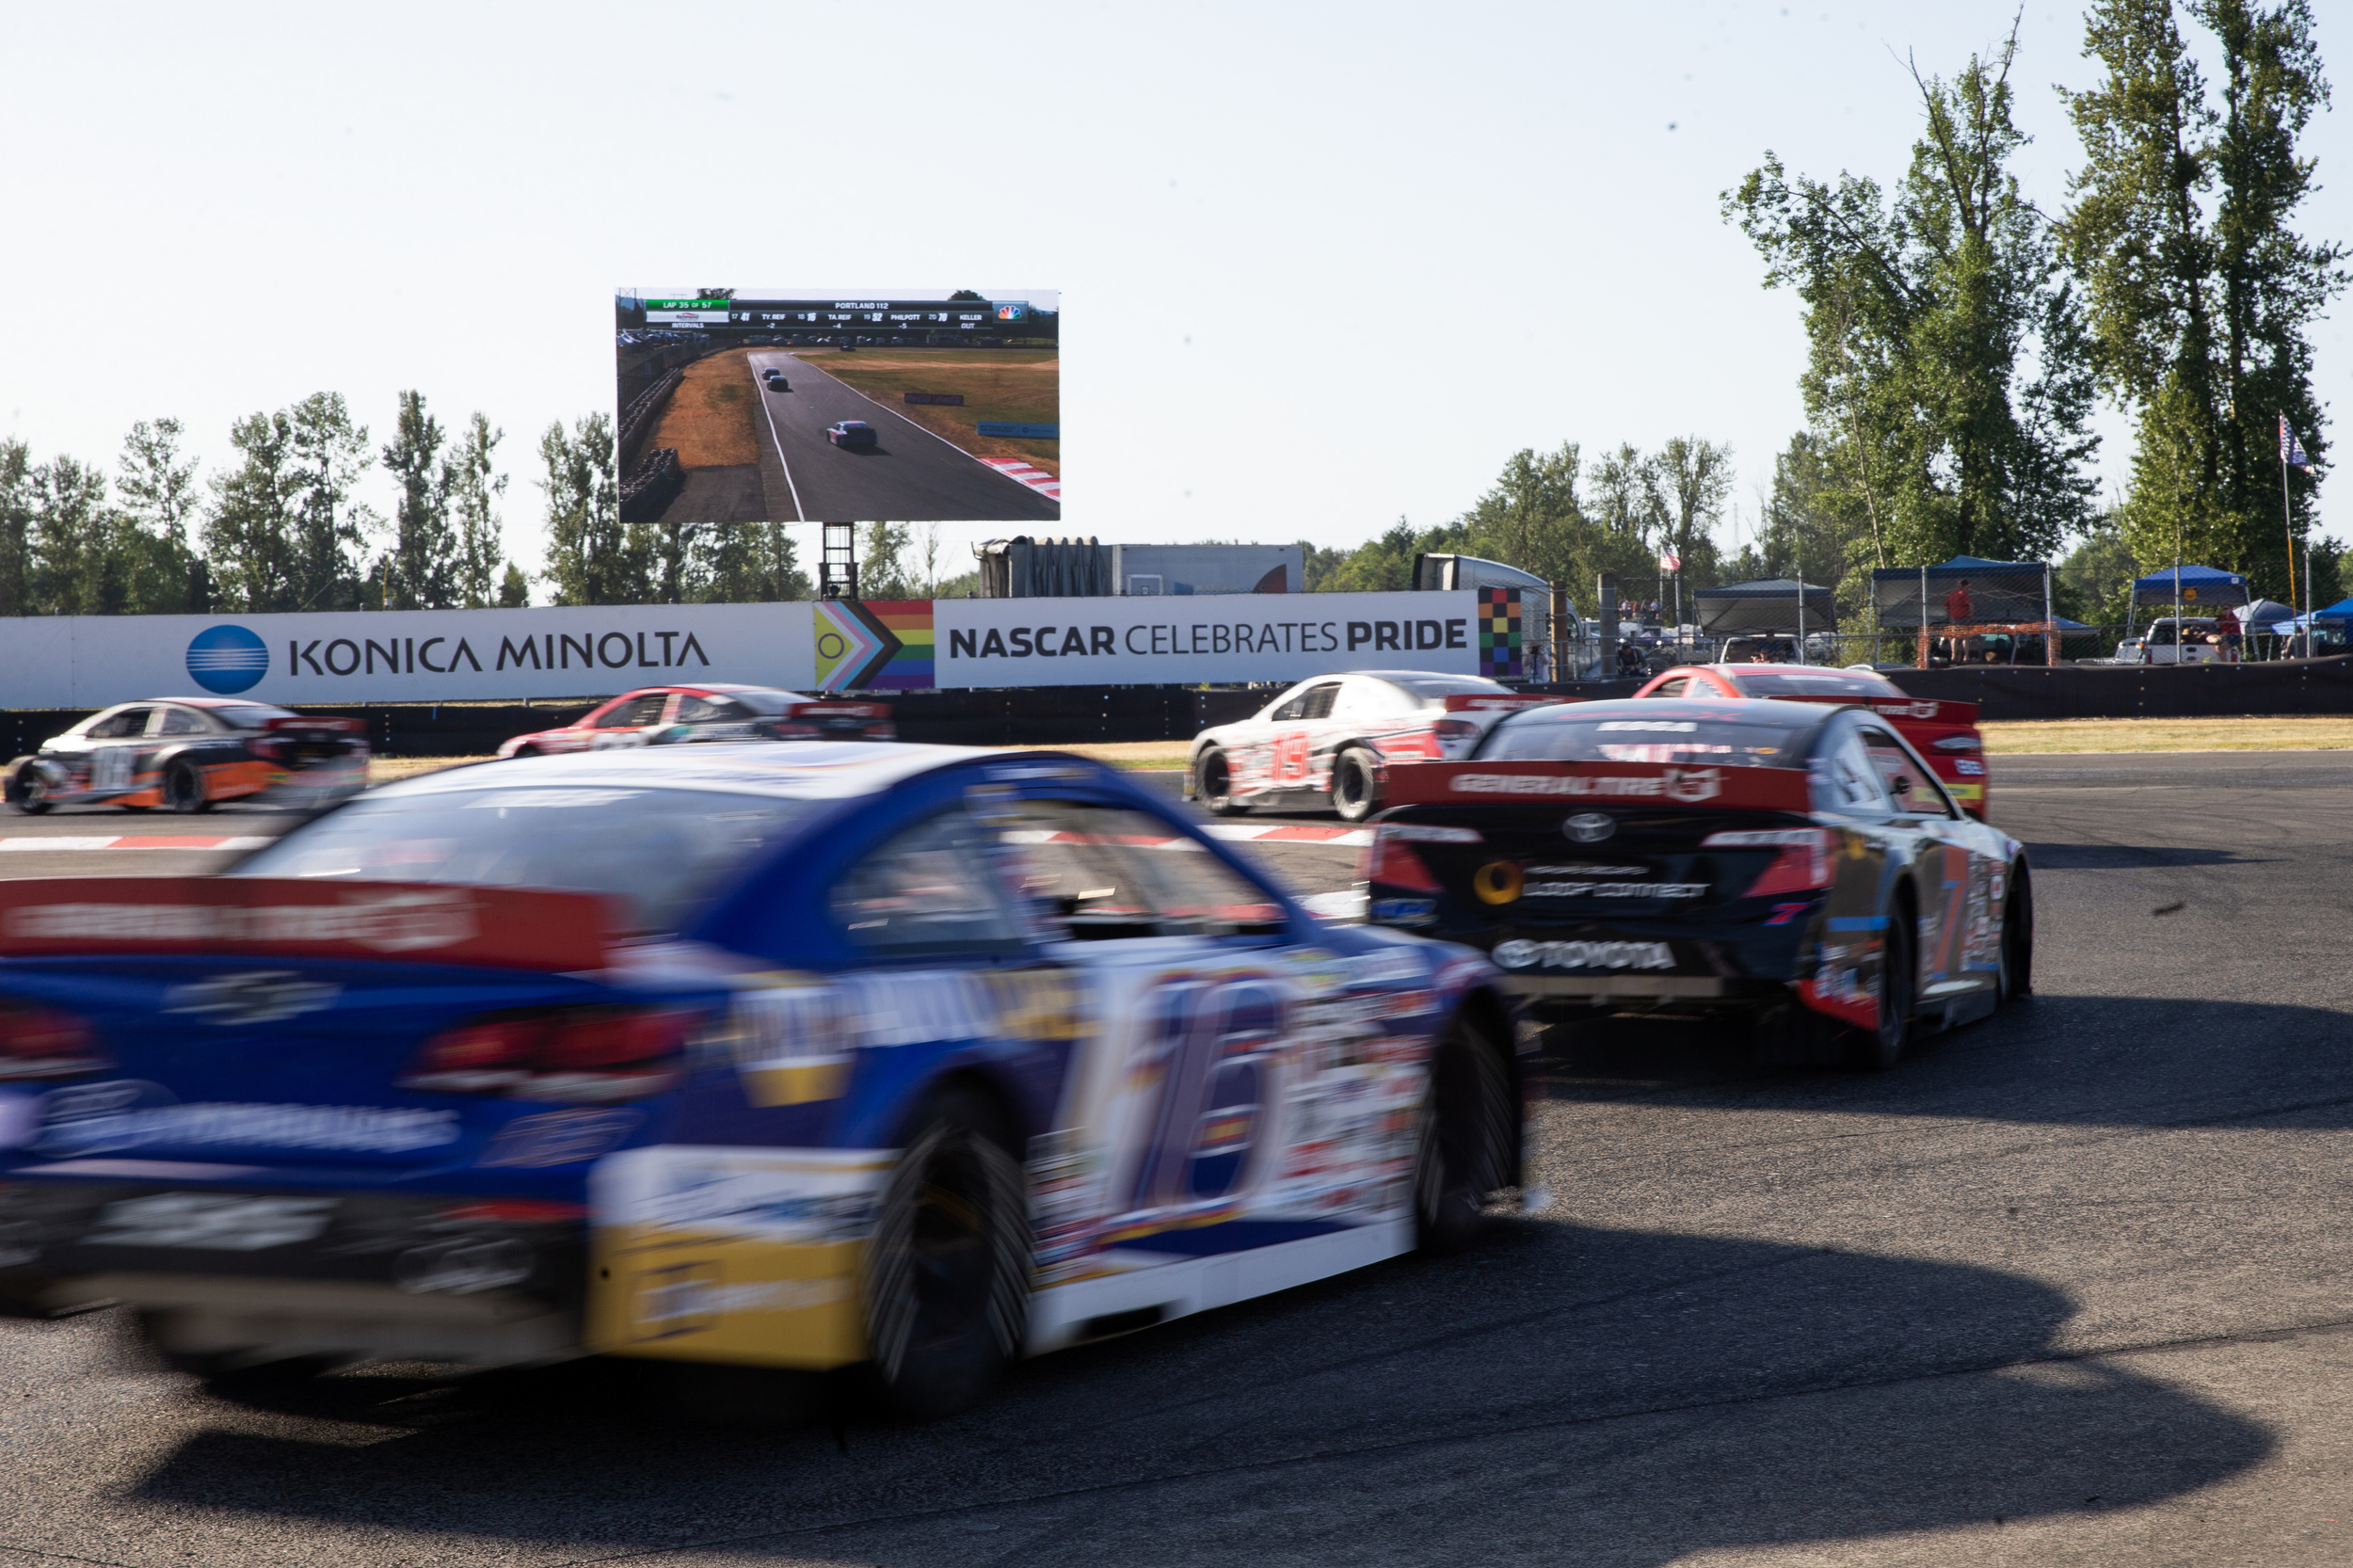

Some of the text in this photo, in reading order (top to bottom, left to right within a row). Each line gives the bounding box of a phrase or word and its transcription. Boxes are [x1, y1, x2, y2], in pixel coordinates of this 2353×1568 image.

[740, 312, 751, 322] 41
[807, 312, 817, 322] 16
[872, 312, 883, 322] 52
[949, 617, 1467, 659] NASCAR CELEBRATES PRIDE
[289, 631, 711, 677] KONICA MINOLTA
[1449, 773, 1594, 795] GENERAL
[1762, 901, 1813, 927] 7
[1538, 940, 1678, 969] TOYOTA
